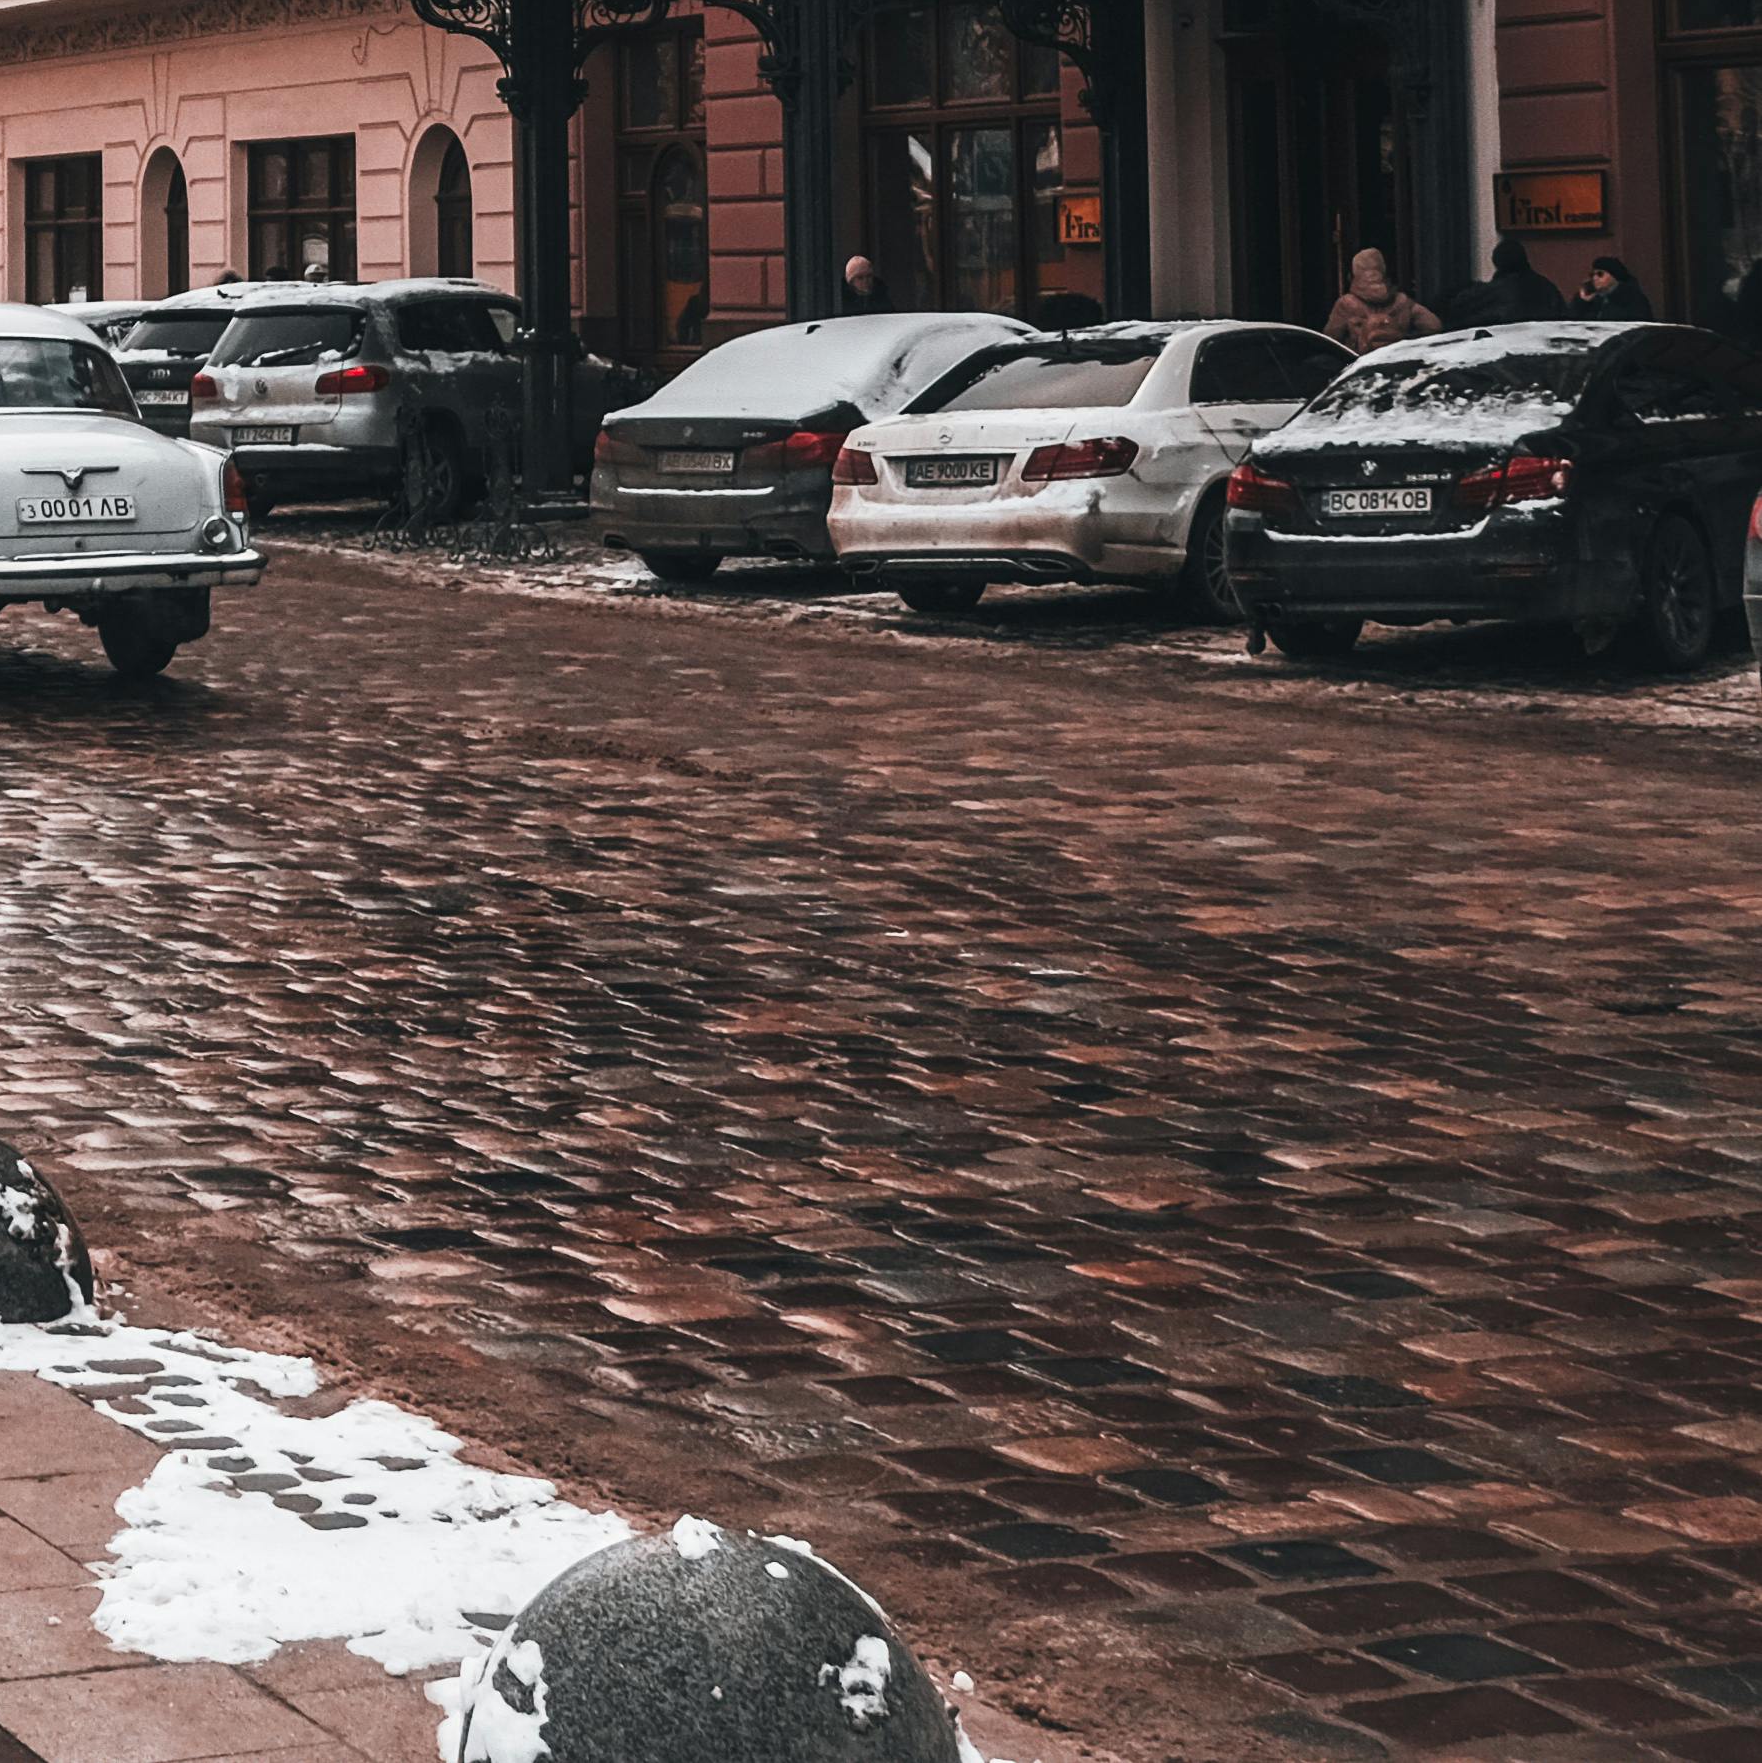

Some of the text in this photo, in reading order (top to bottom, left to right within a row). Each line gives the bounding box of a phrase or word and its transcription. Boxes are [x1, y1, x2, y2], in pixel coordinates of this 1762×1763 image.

[915, 462, 990, 479] AE 9000 KE
[40, 498, 93, 518] 0001
[1331, 491, 1428, 511] BC 0814 OB
